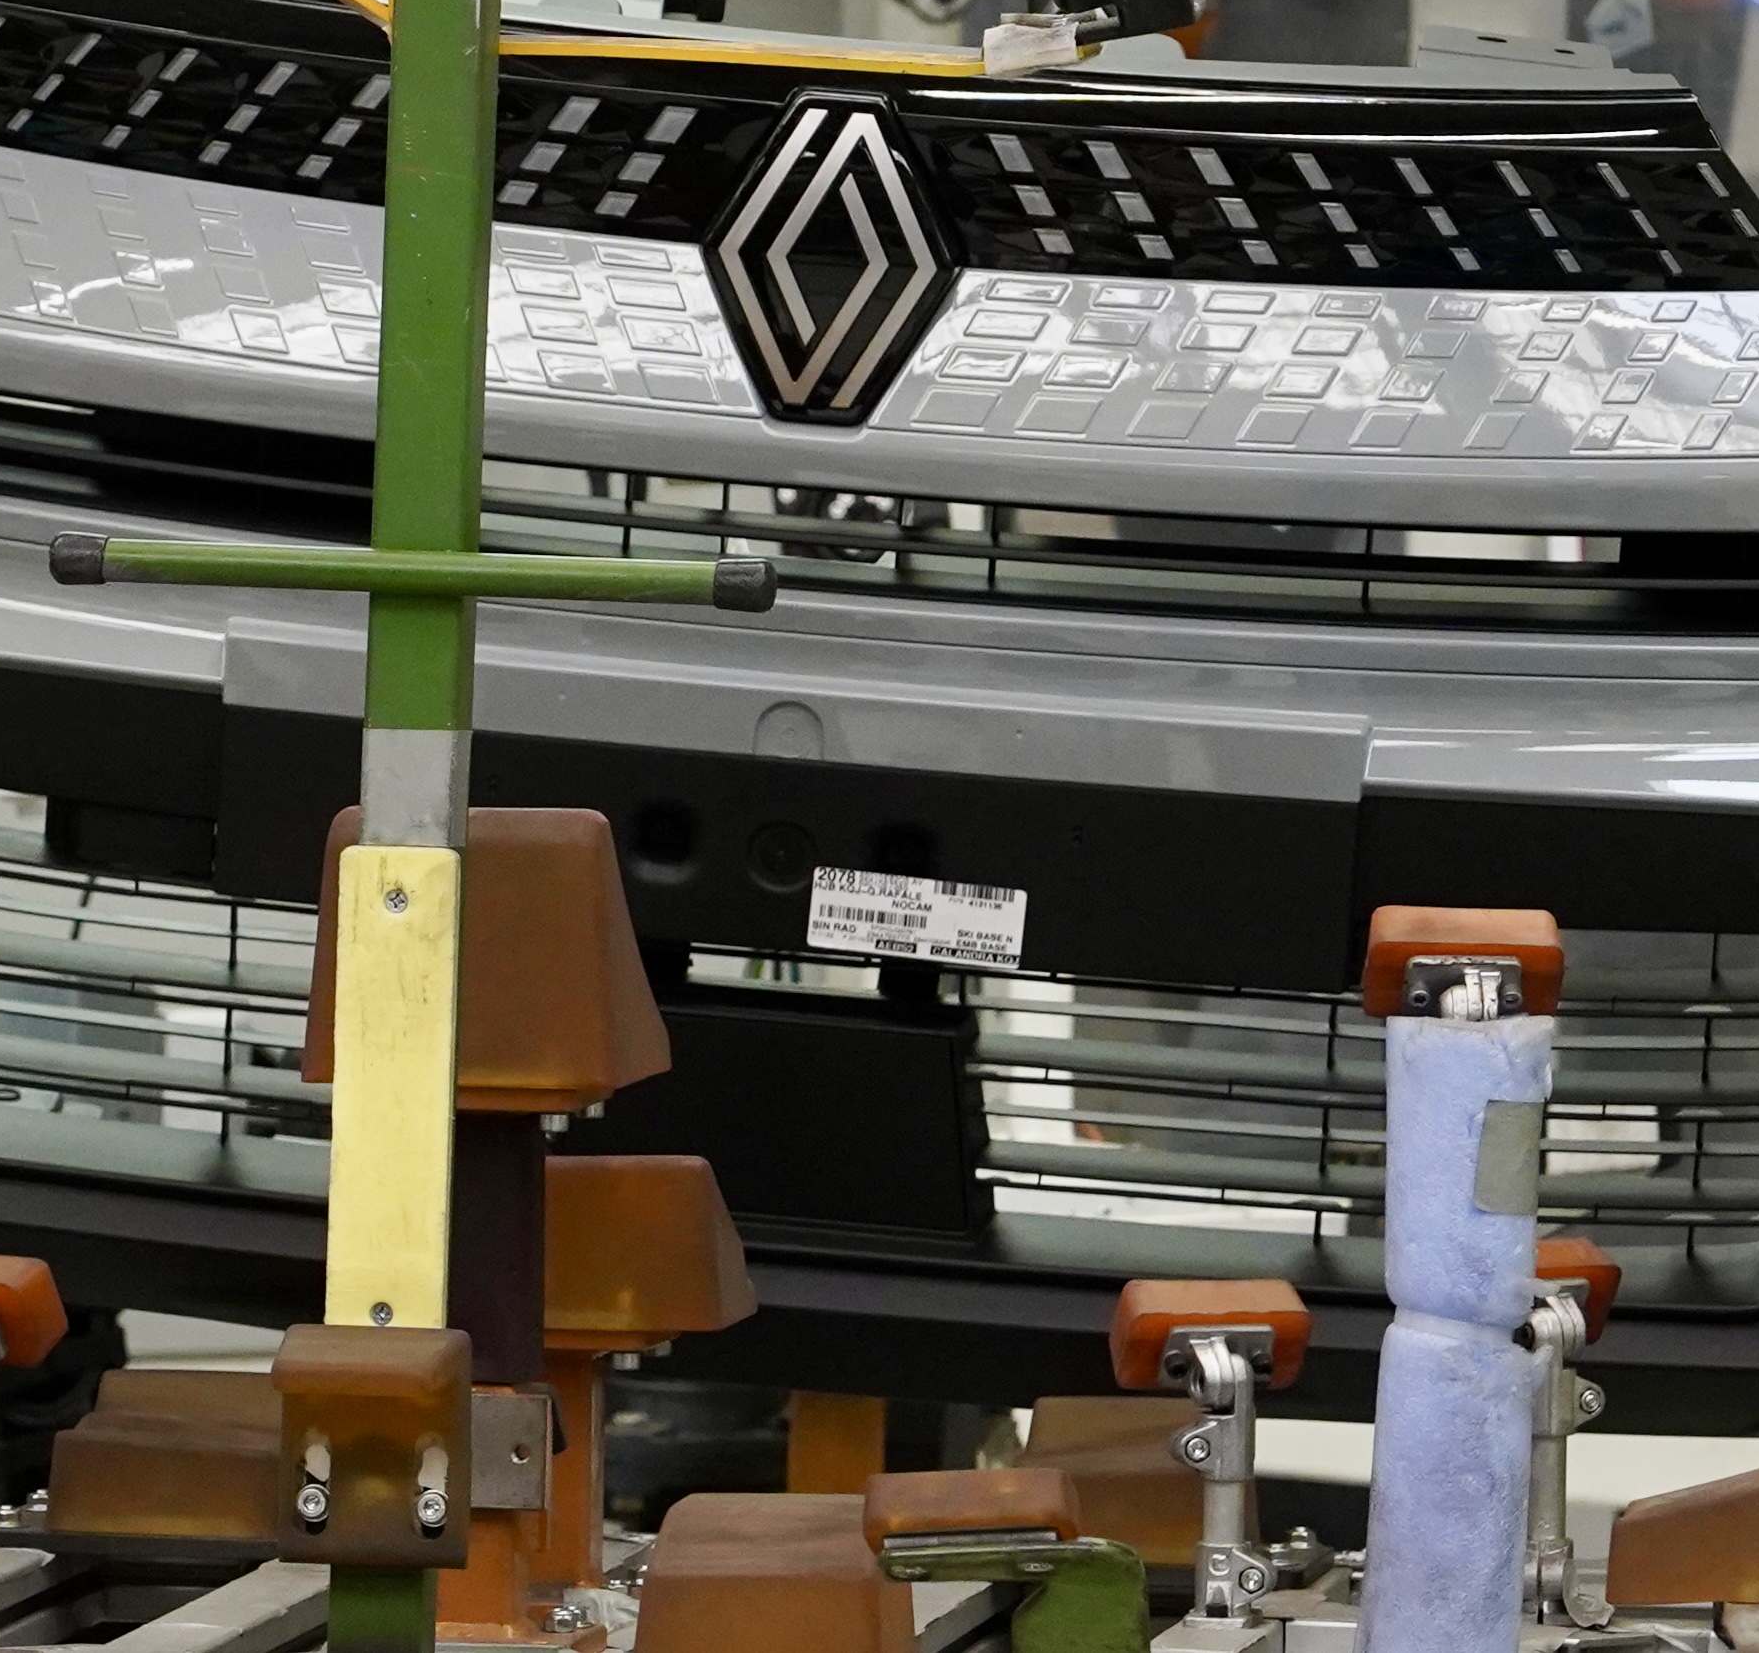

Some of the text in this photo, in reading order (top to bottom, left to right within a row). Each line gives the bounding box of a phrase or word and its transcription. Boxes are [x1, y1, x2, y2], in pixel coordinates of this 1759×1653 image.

[817, 867, 856, 886] 2078
[892, 899, 933, 913] NOCAM
[834, 921, 857, 934] RAD
